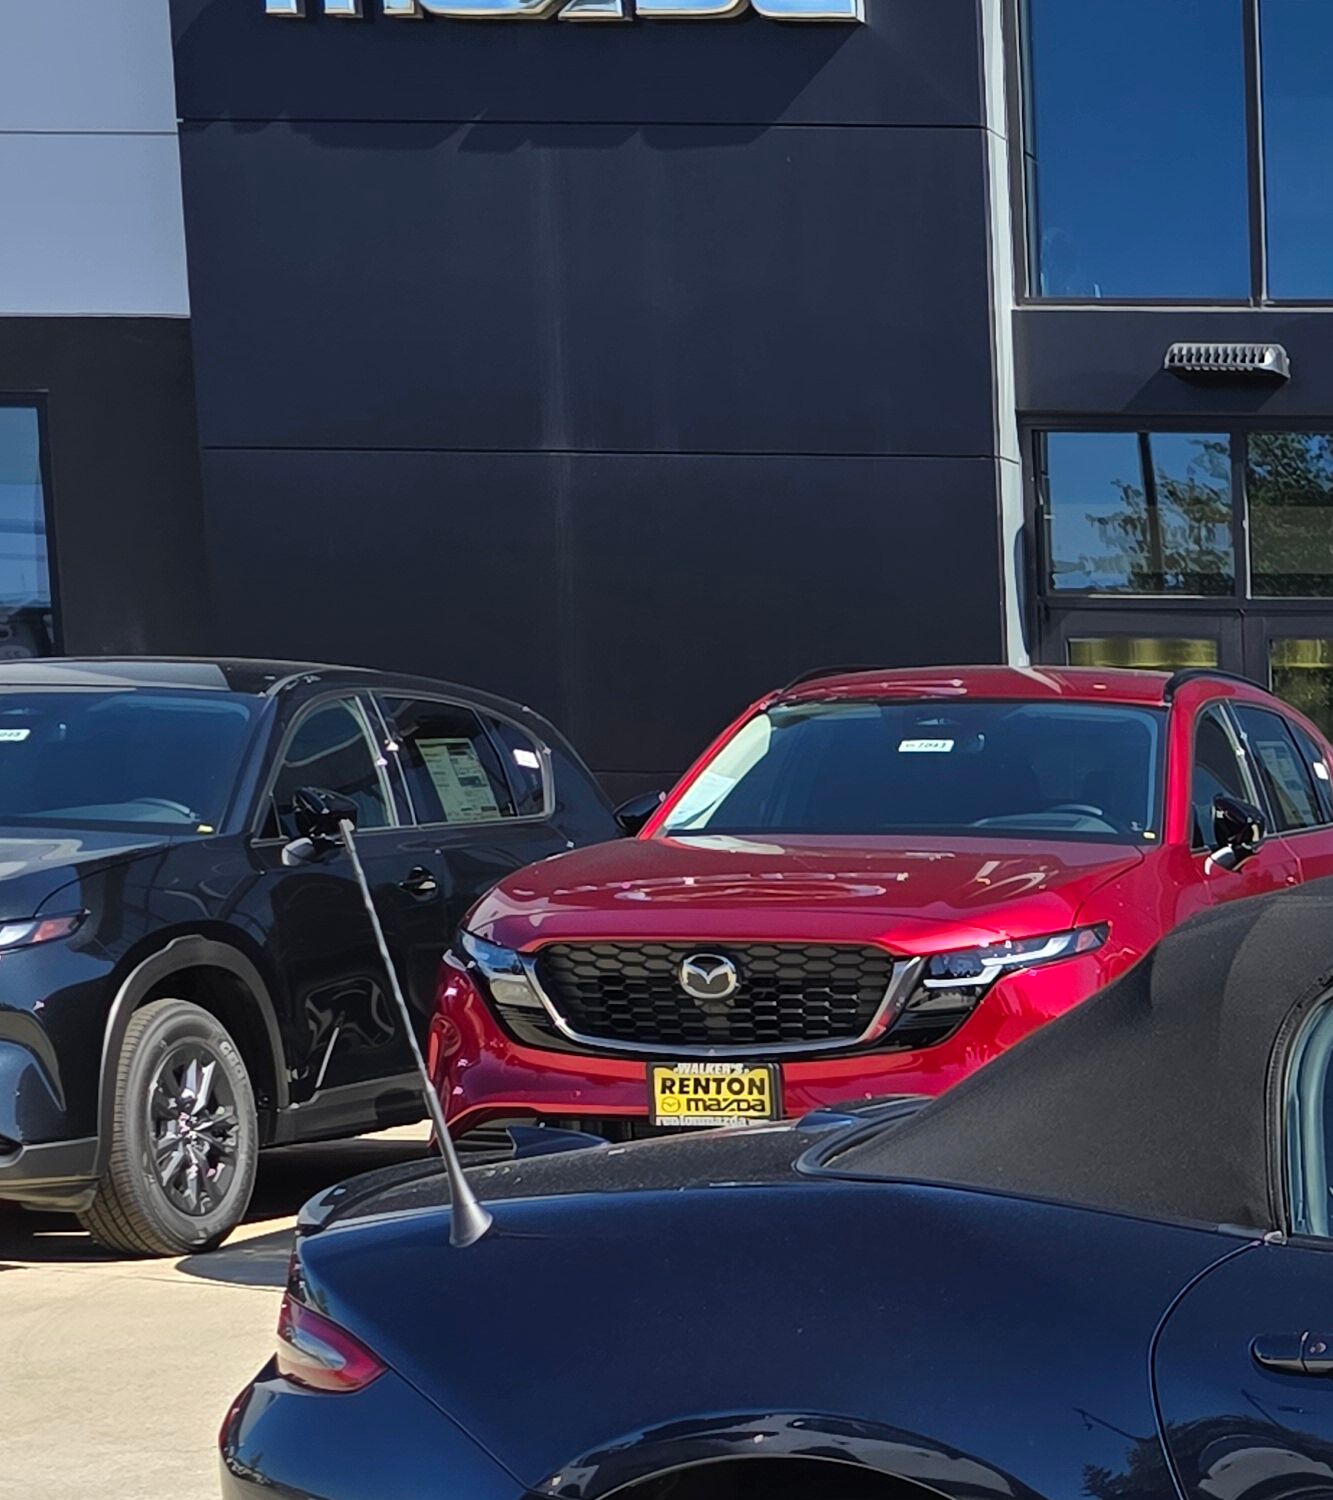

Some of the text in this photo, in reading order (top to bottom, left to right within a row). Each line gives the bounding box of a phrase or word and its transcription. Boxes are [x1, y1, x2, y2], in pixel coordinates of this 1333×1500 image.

[677, 1062, 744, 1075] WALKER'S
[660, 1077, 766, 1096] RENTON
[686, 1097, 766, 1112] mazda
